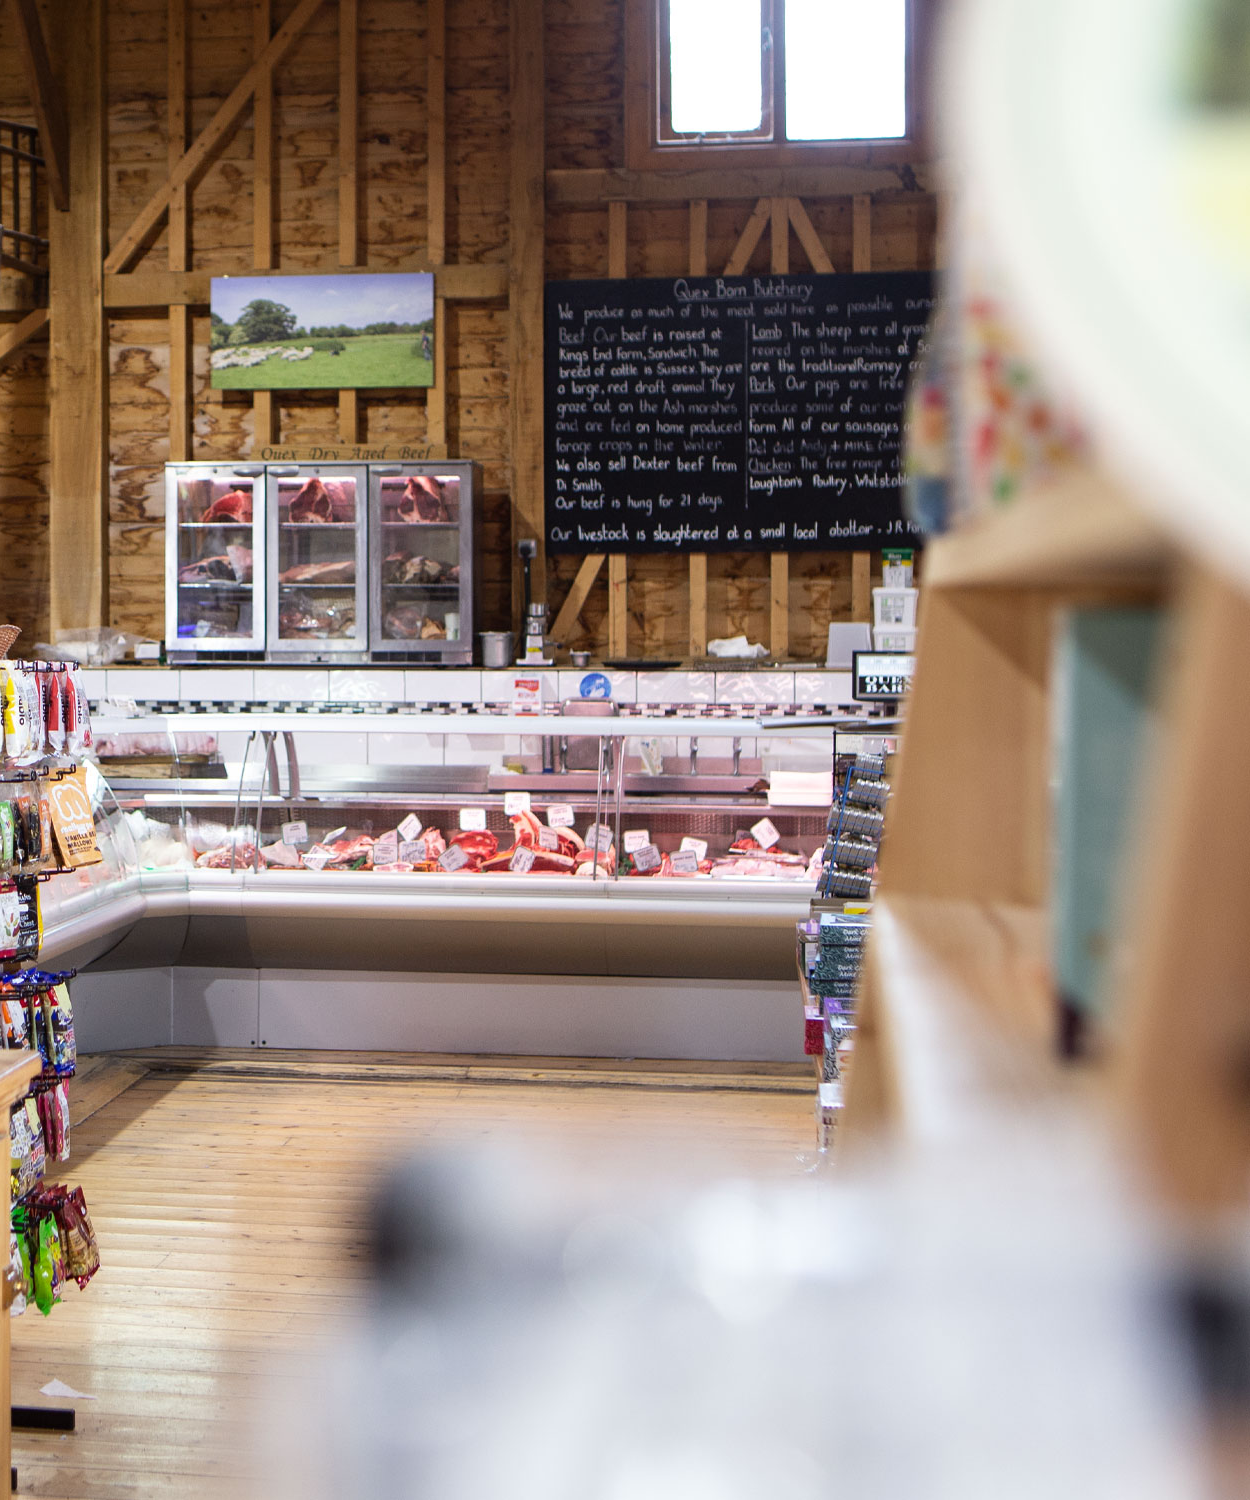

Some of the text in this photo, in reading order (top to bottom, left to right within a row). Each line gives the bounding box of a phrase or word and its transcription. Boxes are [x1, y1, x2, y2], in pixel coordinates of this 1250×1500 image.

[674, 278, 813, 302] Quex Barn Butchery
[558, 303, 573, 319] We
[584, 305, 624, 325] produce
[648, 305, 674, 317] much
[681, 305, 691, 317] of
[701, 305, 718, 317] the
[764, 303, 787, 316] sold
[621, 325, 722, 342] beef is raised at
[791, 322, 810, 338] The
[816, 322, 851, 341] sheep
[860, 325, 878, 335] are
[885, 321, 897, 334] all
[559, 348, 588, 367] Kings
[593, 347, 612, 360] End
[702, 343, 719, 357] The
[898, 342, 909, 354] at
[559, 366, 590, 378] breed
[595, 364, 604, 376] of
[611, 364, 638, 377] cattle
[644, 365, 652, 375] is
[700, 362, 723, 382] They
[725, 364, 742, 374] are
[751, 362, 770, 372] are
[778, 359, 795, 371] the
[557, 384, 565, 394] a
[608, 380, 628, 393] red
[635, 379, 666, 393] draft
[711, 377, 735, 399] They
[750, 375, 775, 392] Pork
[786, 375, 807, 391] Our
[815, 379, 839, 396] pigs
[850, 378, 868, 389] are
[557, 398, 737, 419] graze out on the Ash marshes
[840, 397, 853, 413] of
[611, 418, 630, 432] fed
[636, 423, 650, 434] on
[656, 420, 684, 433] home
[690, 420, 742, 438] produced
[782, 418, 794, 431] All
[801, 416, 813, 431] of
[821, 422, 840, 431] our
[845, 422, 898, 438] sausages
[261, 445, 435, 461] Quex Dry Aged Beef
[801, 456, 817, 470] The
[826, 456, 847, 469] free
[556, 455, 737, 472] We also sell Dexter beef from
[556, 478, 567, 490] Di
[555, 496, 576, 510] Our
[581, 494, 605, 509] beef
[611, 499, 620, 508] is
[627, 495, 652, 516] hung
[659, 494, 673, 508] for
[680, 493, 691, 506] 21
[551, 526, 572, 541] Our
[578, 523, 629, 541] livestock
[637, 531, 645, 541] is
[653, 523, 718, 544] slaughtered
[727, 525, 739, 540] at
[744, 530, 752, 541] a
[760, 522, 785, 538] small
[794, 521, 817, 539] local
